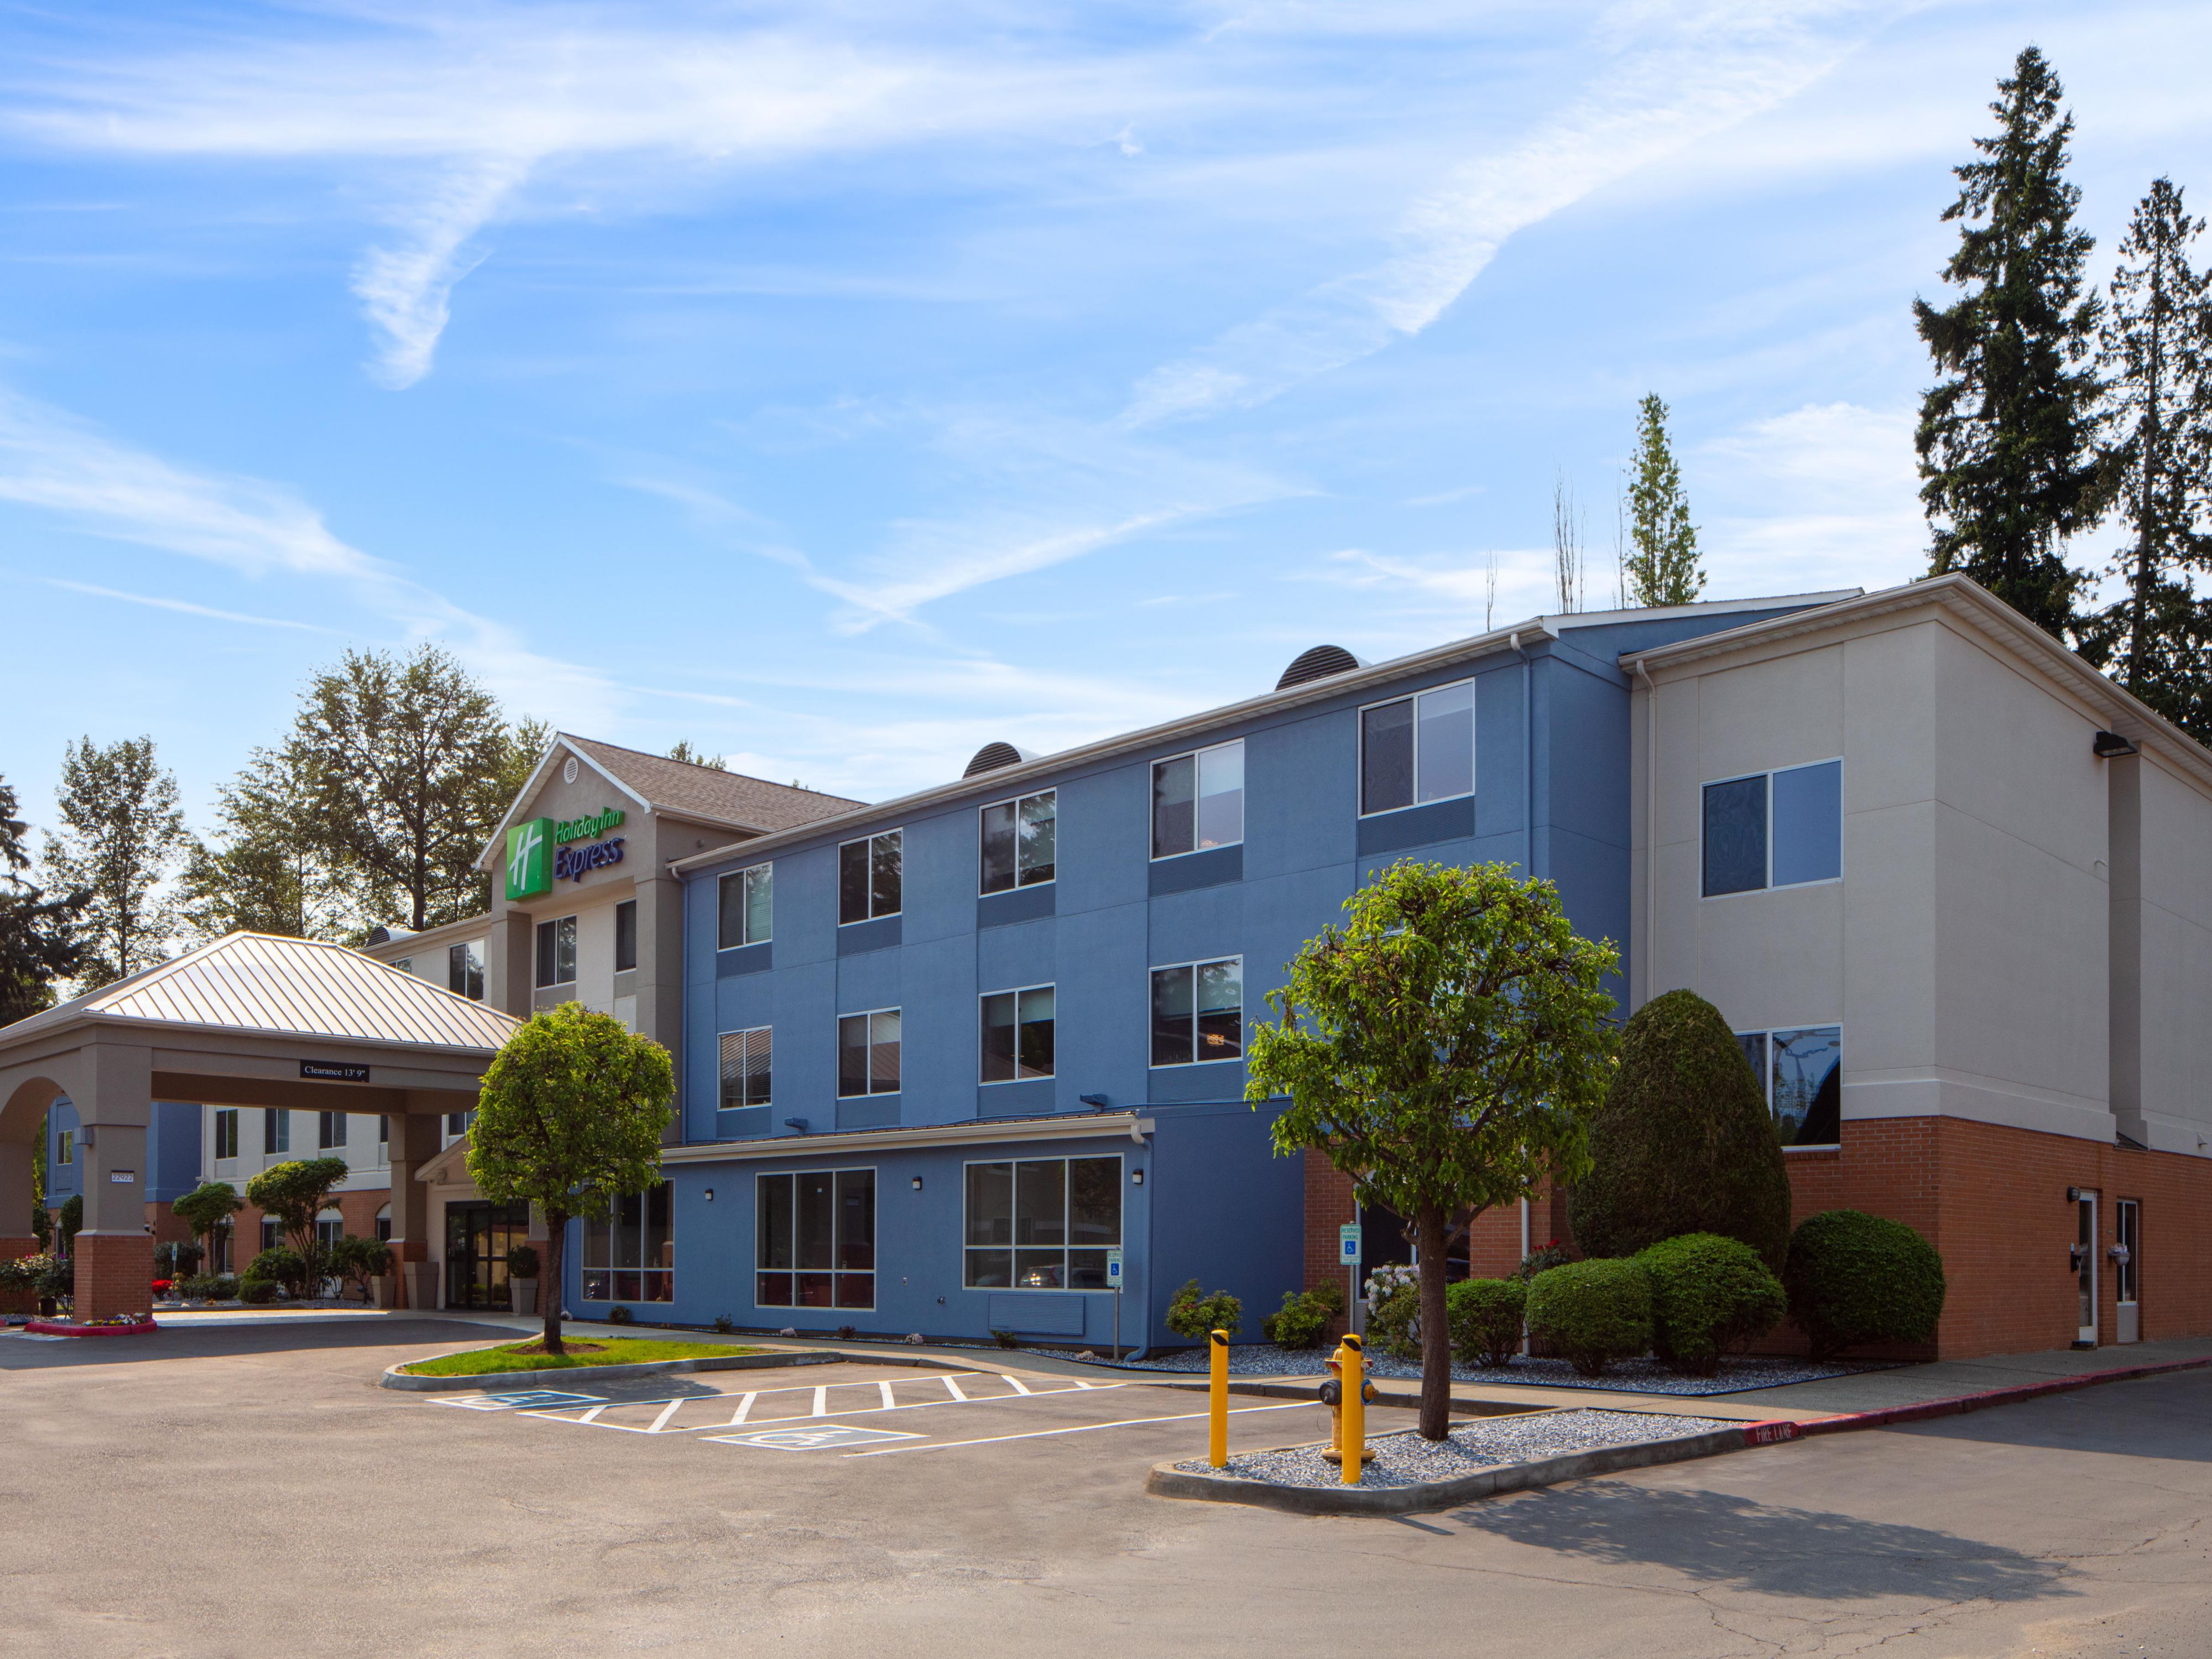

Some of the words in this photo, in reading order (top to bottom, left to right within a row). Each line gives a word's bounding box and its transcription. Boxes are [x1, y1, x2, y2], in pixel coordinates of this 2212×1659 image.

[555, 815, 601, 844] Holiday
[601, 807, 624, 830] Inn
[554, 837, 624, 883] Express
[305, 1066, 342, 1076] Clearance
[345, 1068, 355, 1077] 13'
[1756, 1426, 1772, 1442] FIRE
[1774, 1424, 1792, 1441] LANE
